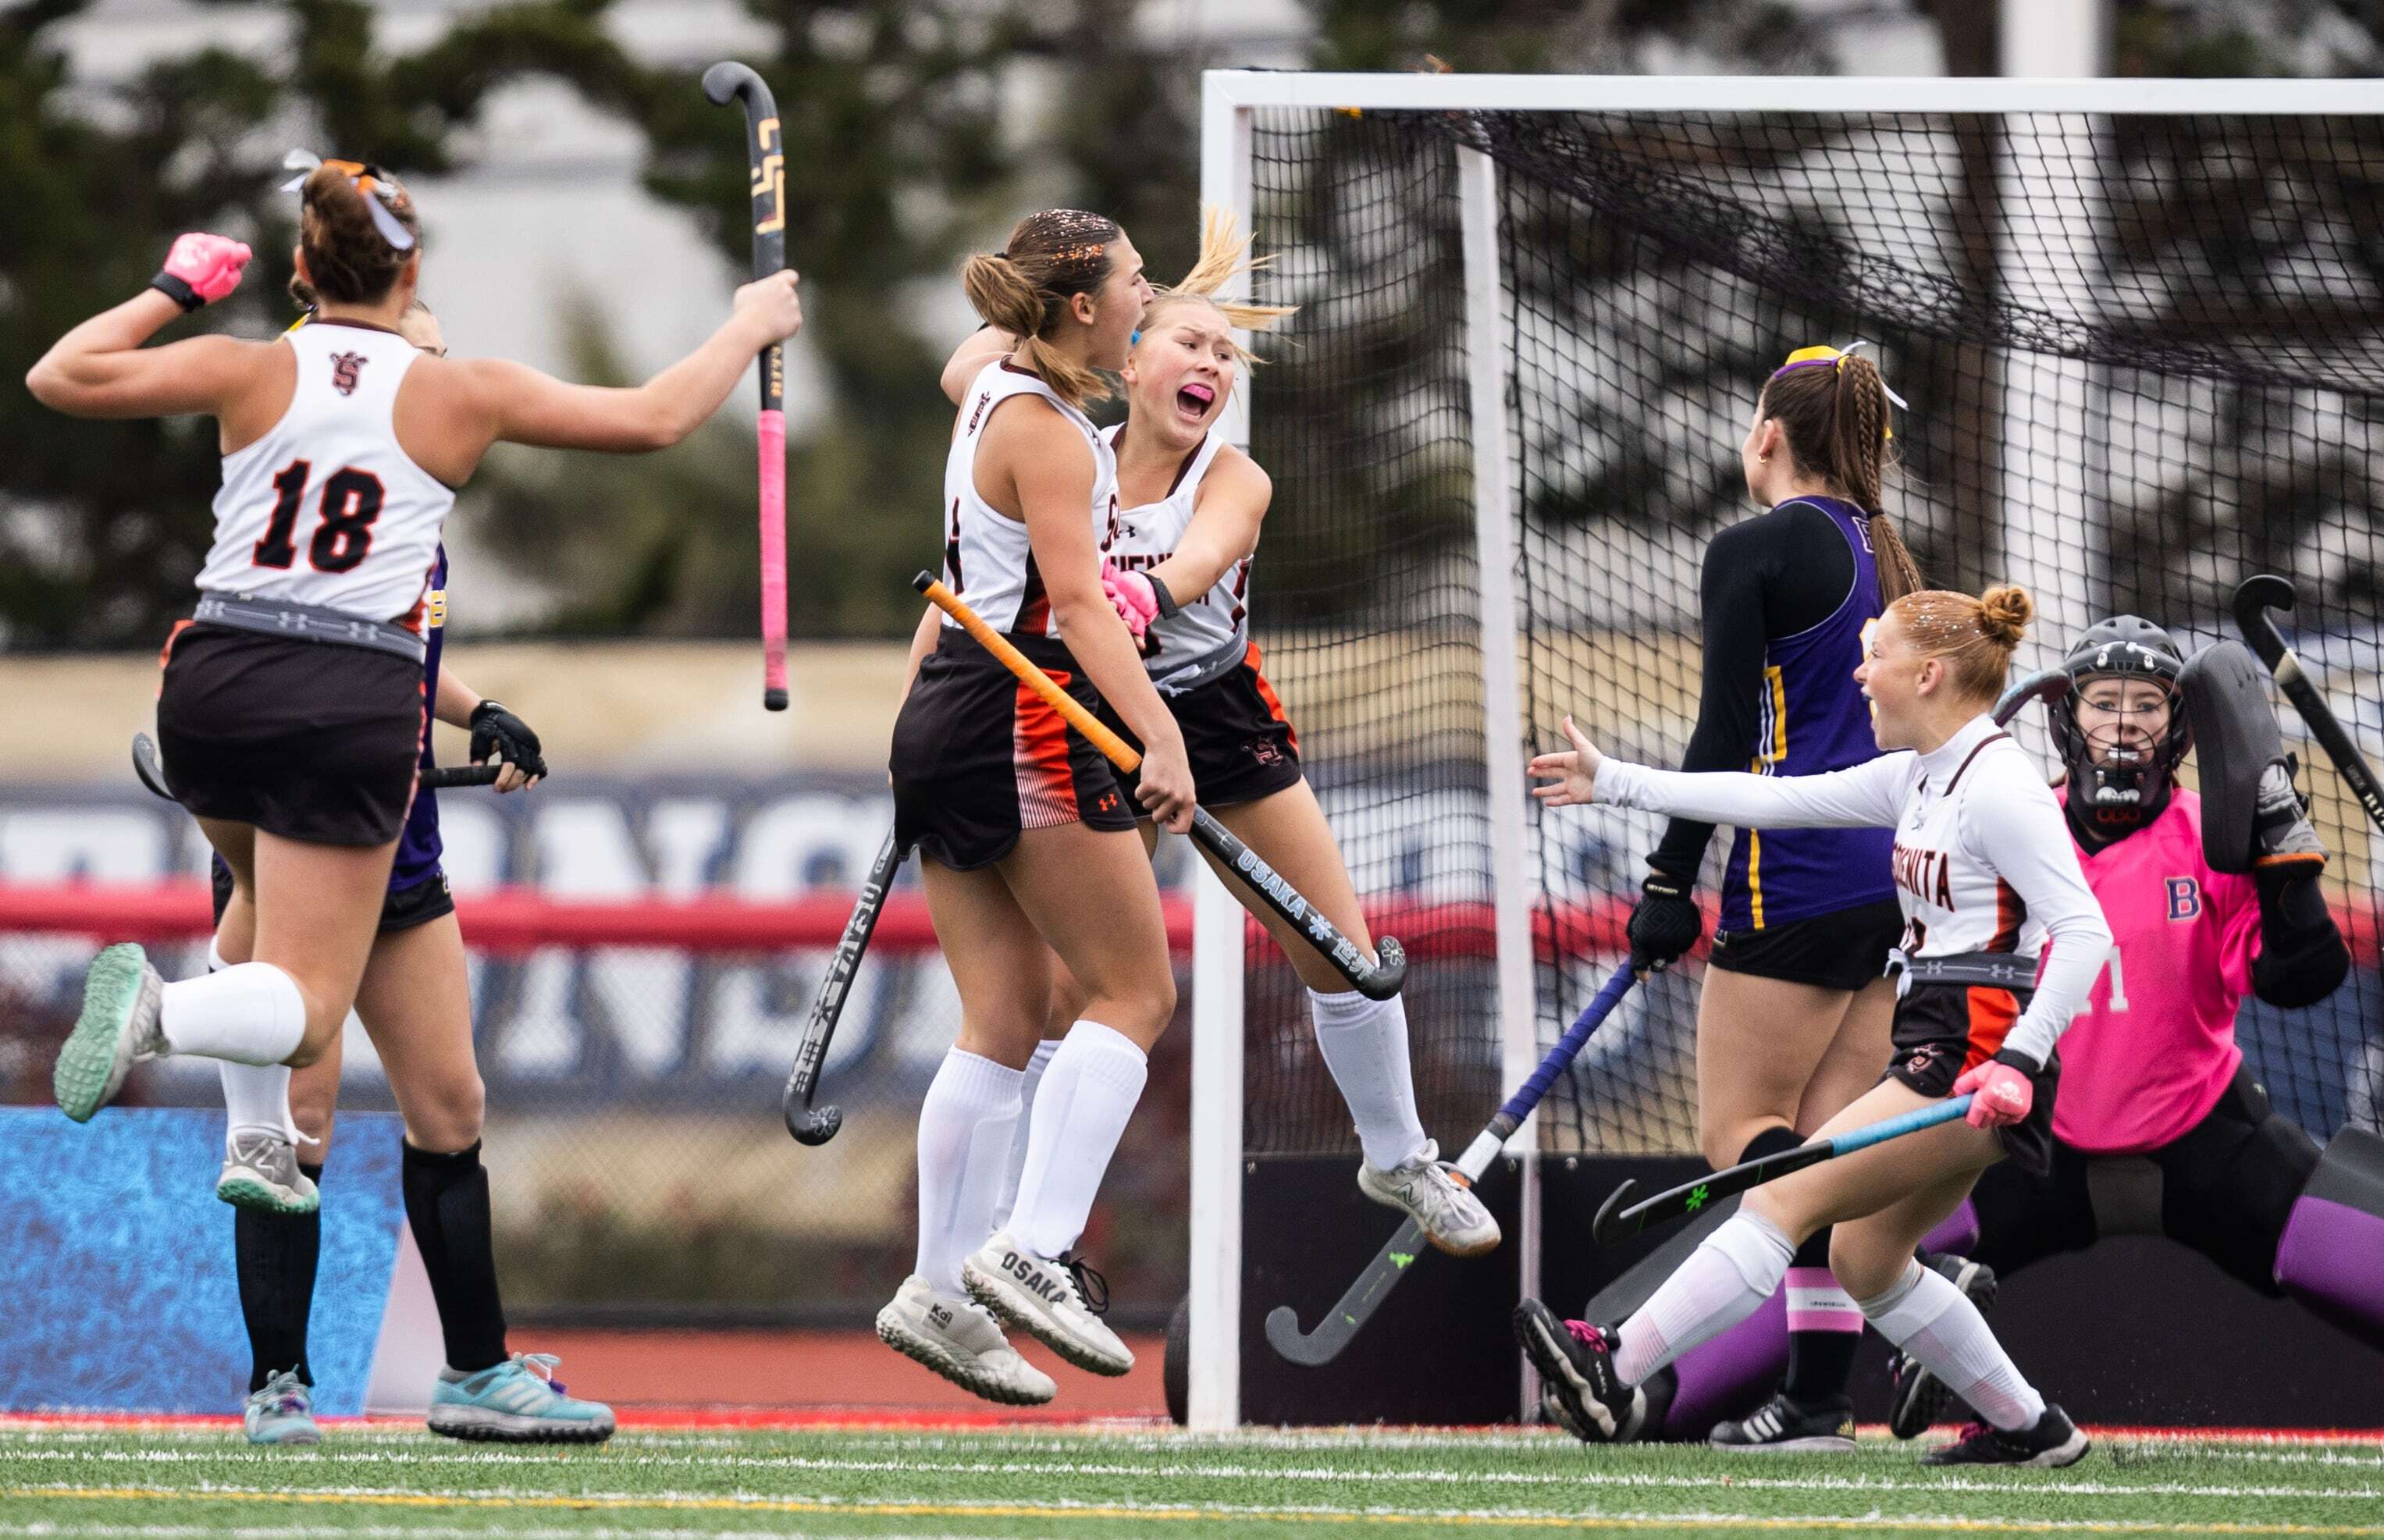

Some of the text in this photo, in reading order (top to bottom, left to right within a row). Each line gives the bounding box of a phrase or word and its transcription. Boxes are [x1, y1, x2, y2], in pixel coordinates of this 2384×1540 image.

[252, 457, 386, 574] 18
[1237, 848, 1306, 919] OSAKA
[2165, 875, 2202, 922] B
[1002, 1251, 1068, 1303] OSAKA
